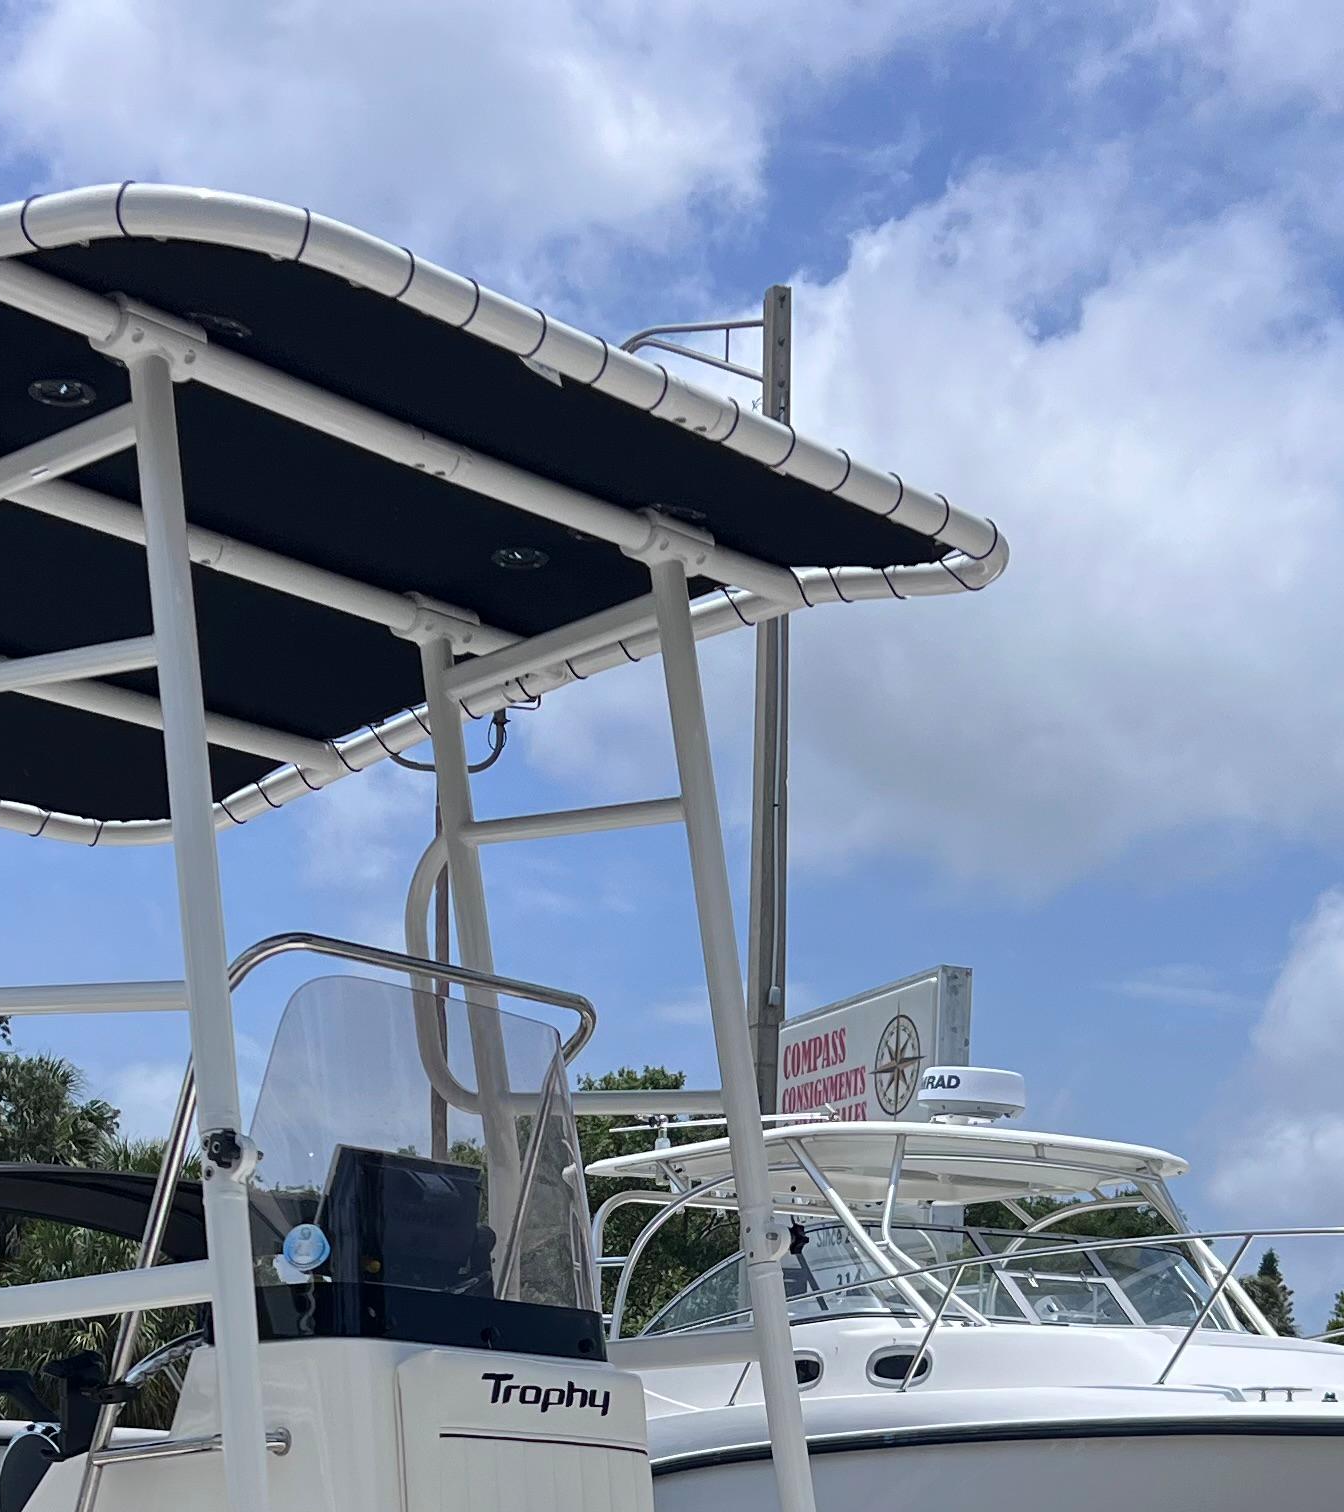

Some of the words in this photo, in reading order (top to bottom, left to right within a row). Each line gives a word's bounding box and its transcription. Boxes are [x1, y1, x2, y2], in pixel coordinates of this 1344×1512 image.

[783, 1027, 846, 1080] COMPASS
[782, 1065, 866, 1114] CONSIGNMENTS
[481, 1372, 611, 1417] Trophy
